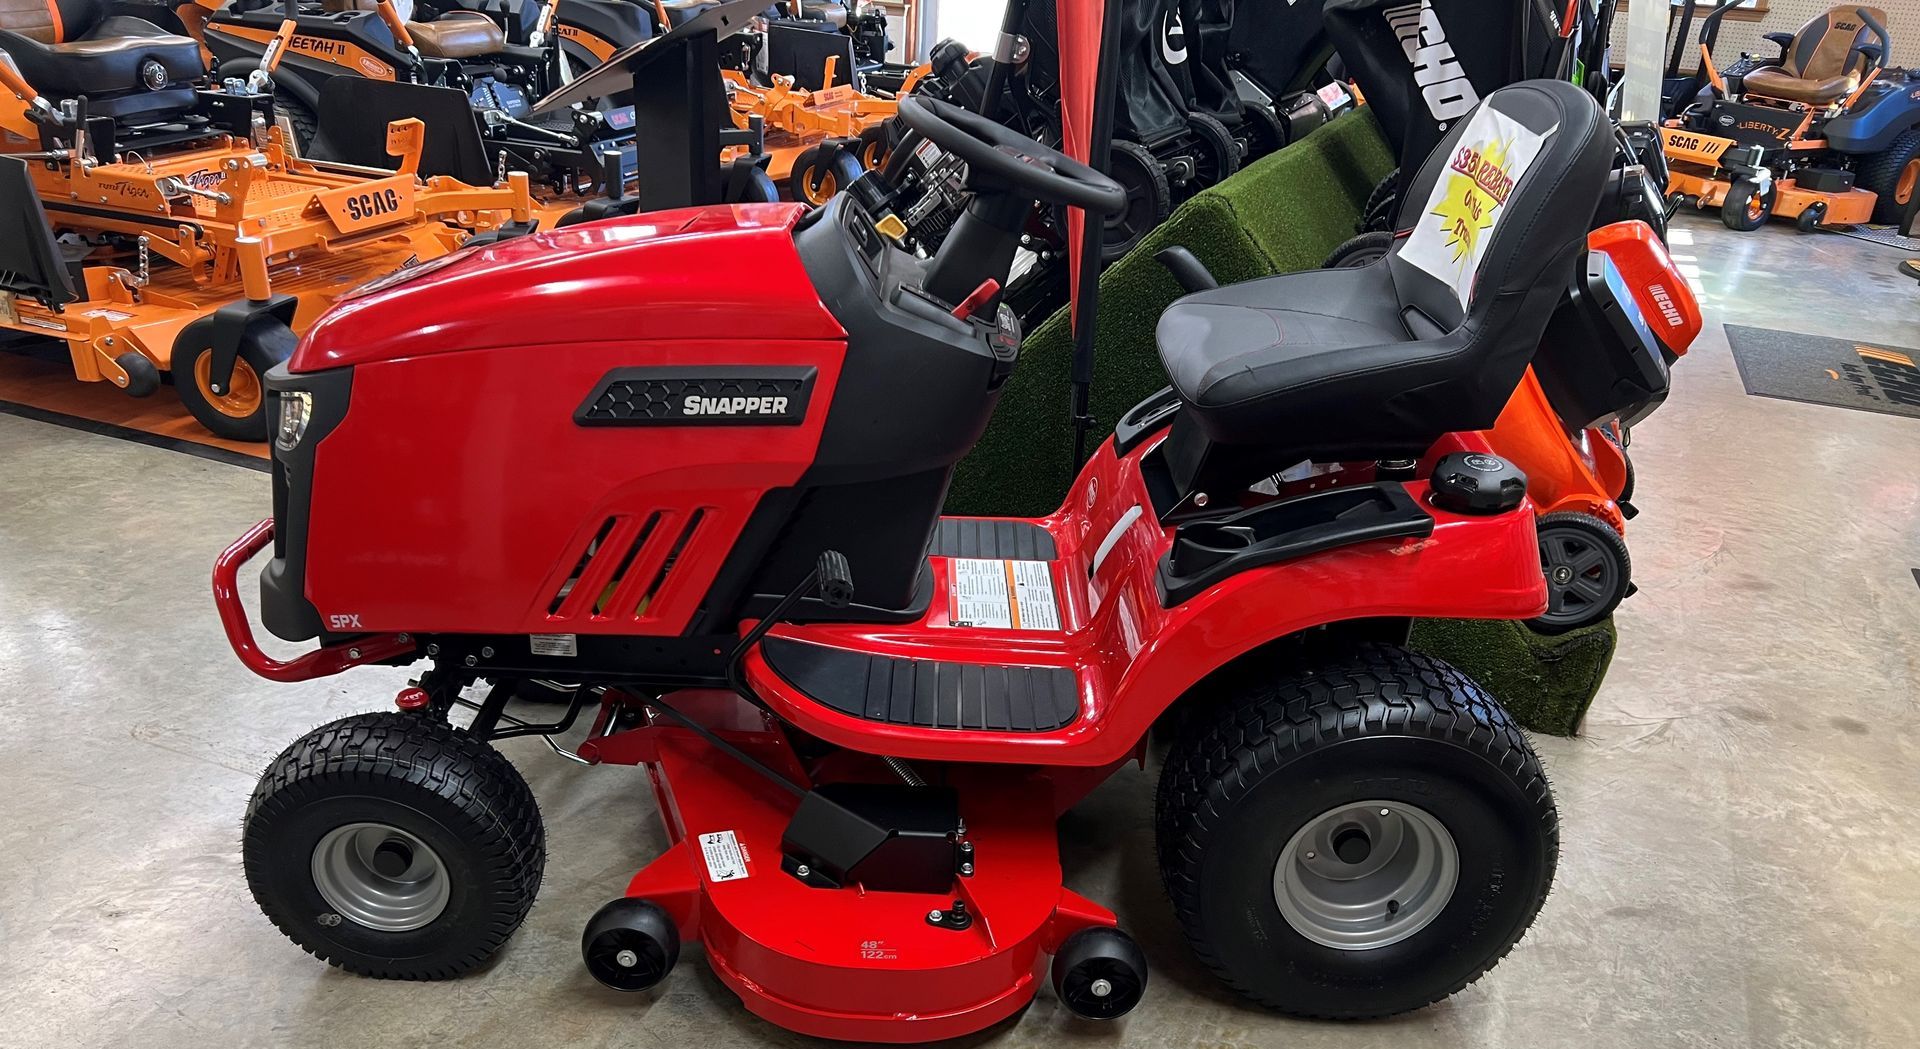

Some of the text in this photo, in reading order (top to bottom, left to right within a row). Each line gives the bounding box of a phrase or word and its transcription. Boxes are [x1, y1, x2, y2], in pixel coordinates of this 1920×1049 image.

[1834, 22, 1857, 31] SCAG
[288, 36, 346, 55] EETAH II
[1402, 0, 1481, 121] CHO
[1739, 121, 1776, 135] LIBERTY
[1669, 135, 1699, 150] SCAG
[347, 188, 398, 221] SCAG
[1654, 287, 1684, 327] ECHO
[683, 395, 788, 415] SNAPPER
[330, 614, 362, 628] SPX
